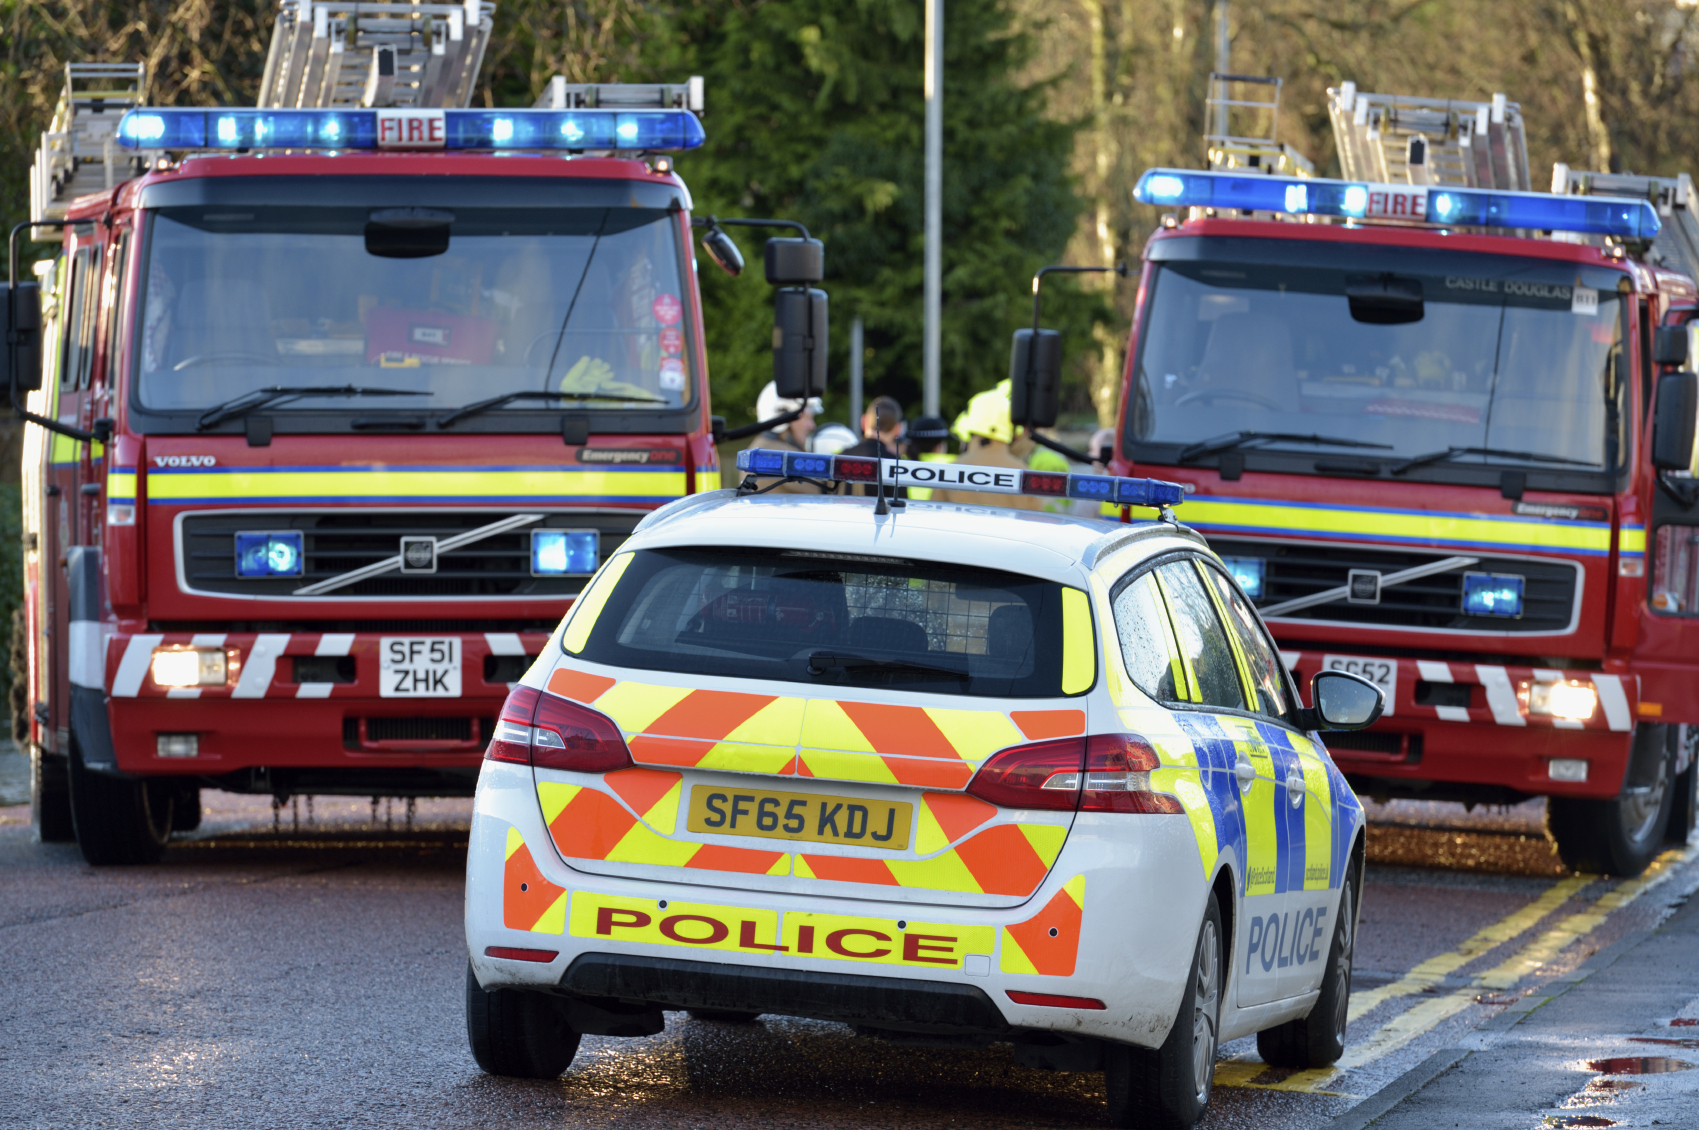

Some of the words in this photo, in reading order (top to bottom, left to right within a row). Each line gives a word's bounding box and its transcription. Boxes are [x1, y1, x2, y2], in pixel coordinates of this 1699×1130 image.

[380, 117, 443, 142] FIRE
[1368, 191, 1426, 217] FIRE
[1445, 276, 1498, 292] CASTLE
[1503, 280, 1571, 300] DOUGLAS
[153, 455, 216, 468] VOLVO
[888, 465, 1015, 488] POLICE
[393, 669, 450, 692] ZHK
[704, 793, 808, 834] SF65
[817, 802, 896, 841] KDJ
[596, 906, 959, 966] POLICE
[1246, 906, 1327, 974] POLICE
